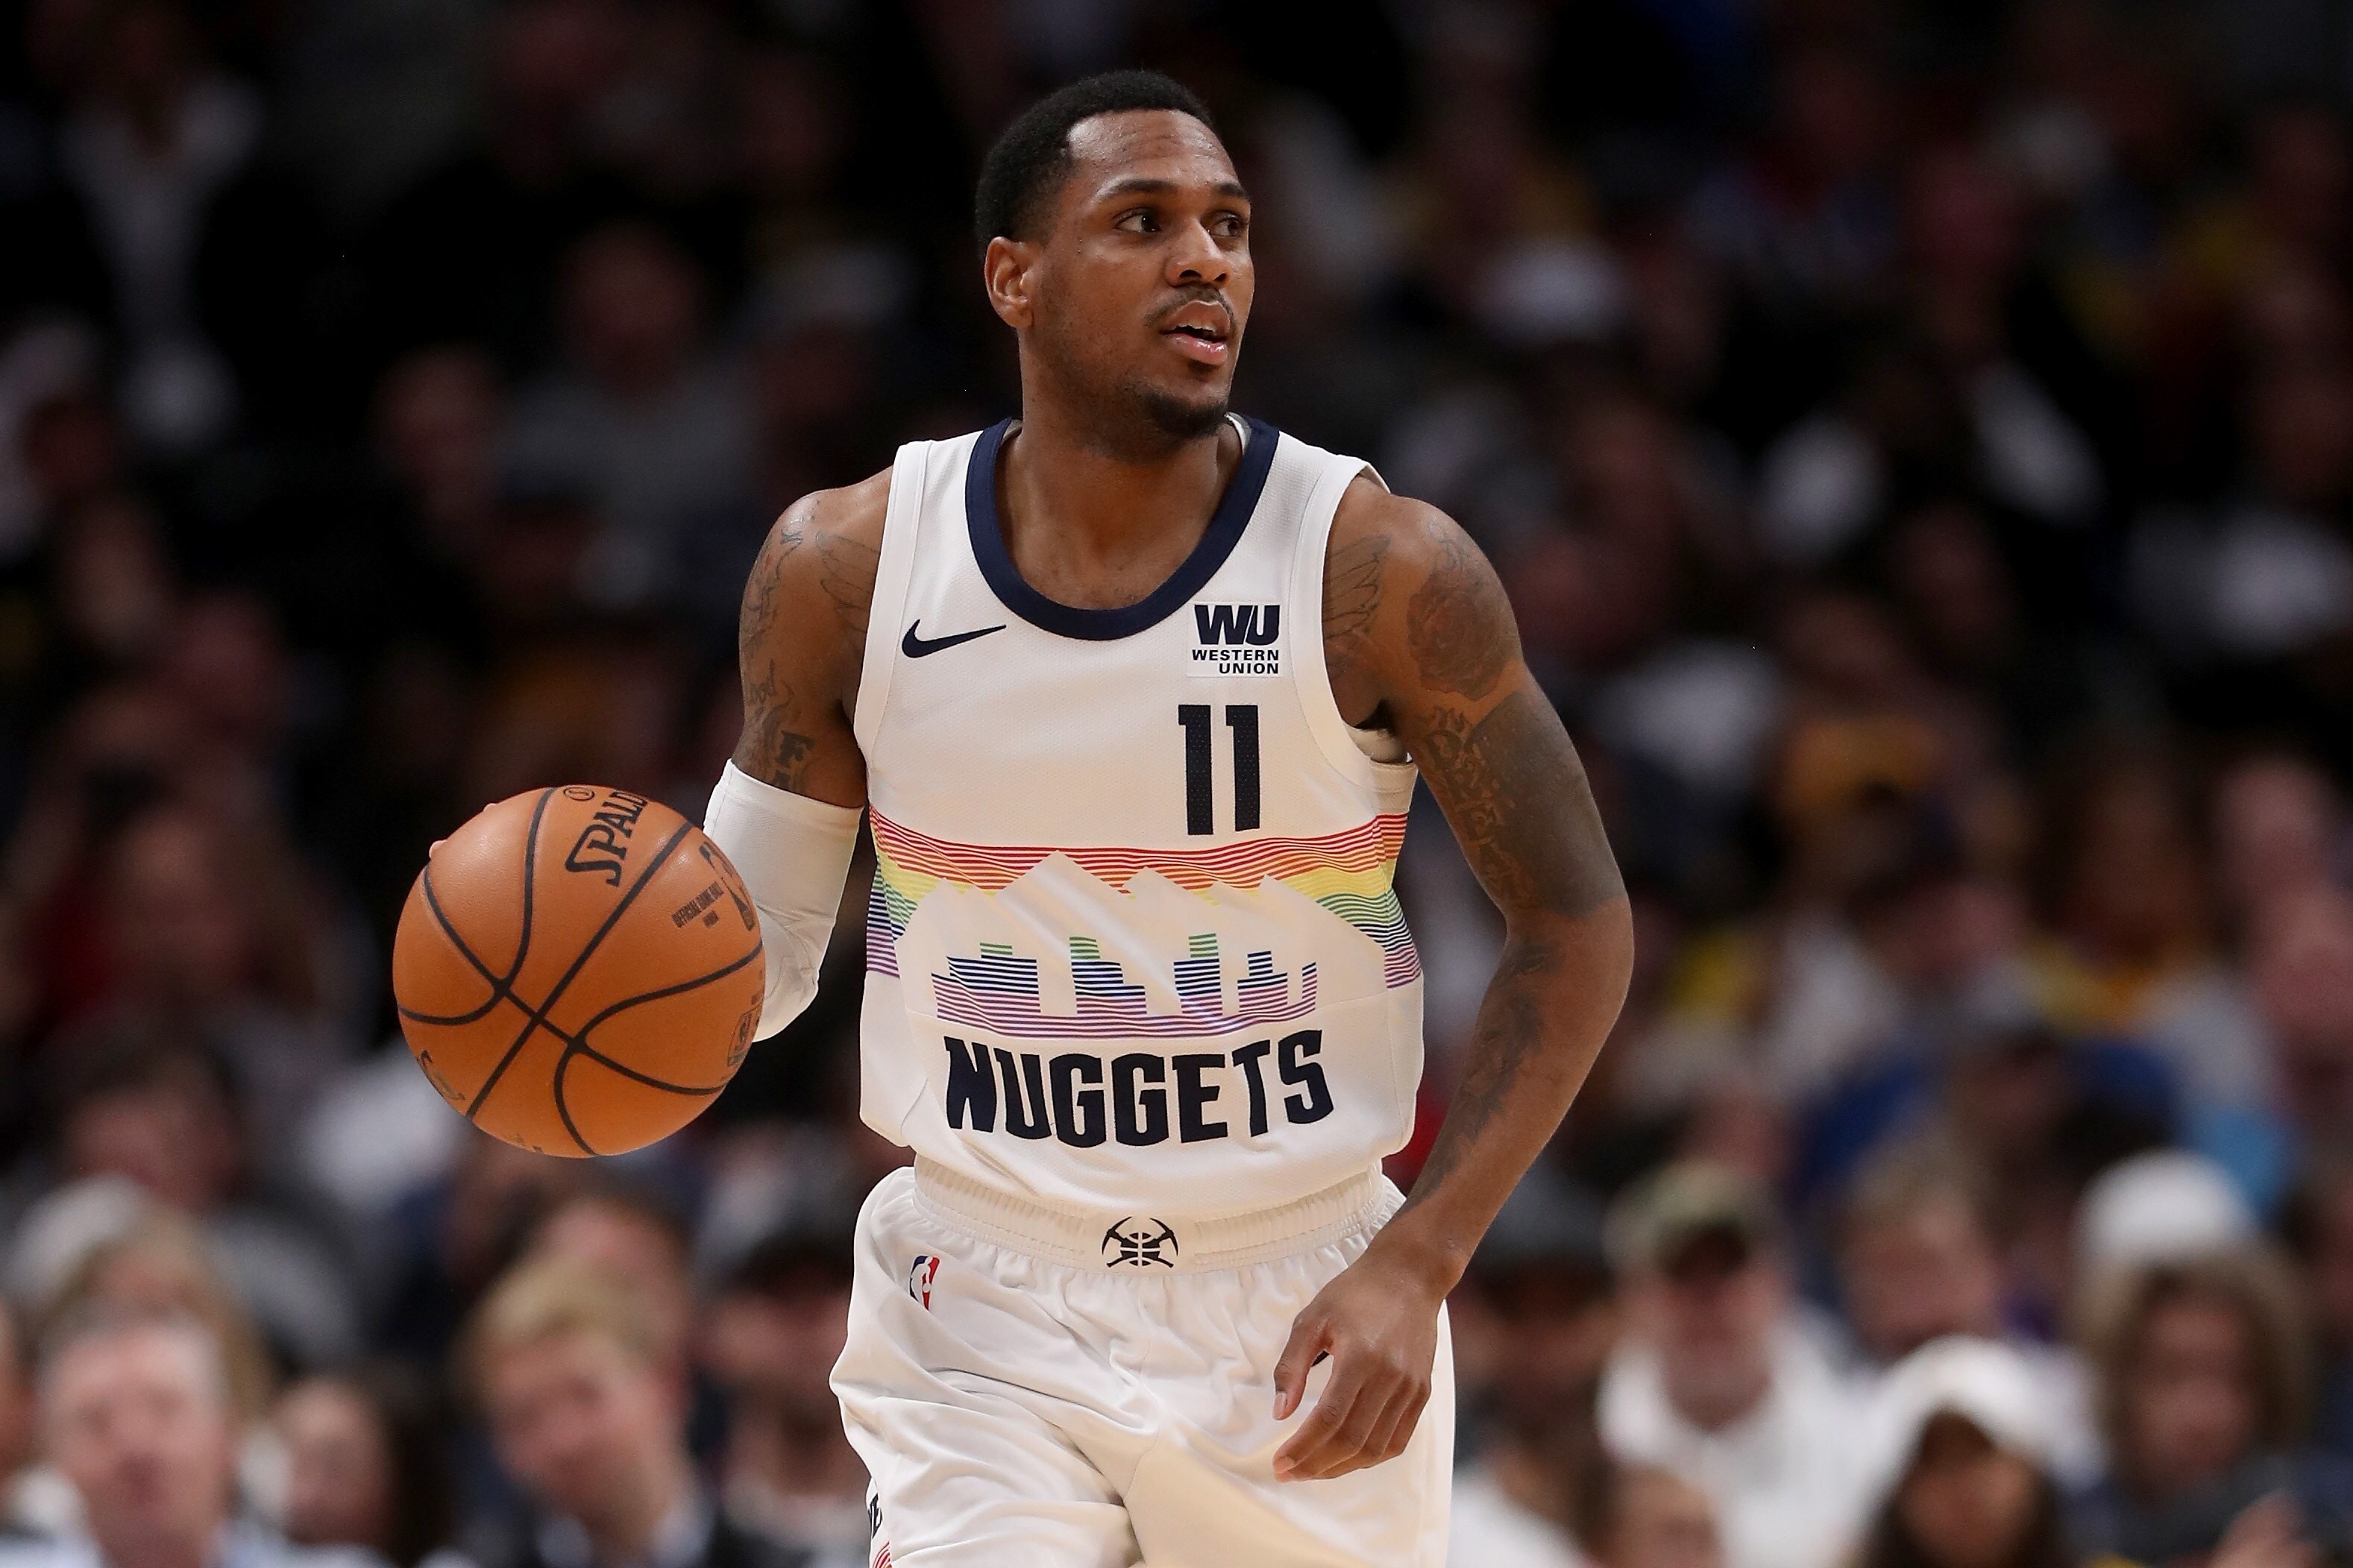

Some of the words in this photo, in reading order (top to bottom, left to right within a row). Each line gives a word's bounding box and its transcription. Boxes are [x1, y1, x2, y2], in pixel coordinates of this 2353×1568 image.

[1194, 605, 1281, 646] WU
[1191, 649, 1280, 661] WESTERN
[1219, 662, 1279, 675] UNION
[1178, 705, 1260, 836] 11
[943, 1029, 1334, 1149] NUGGETS
